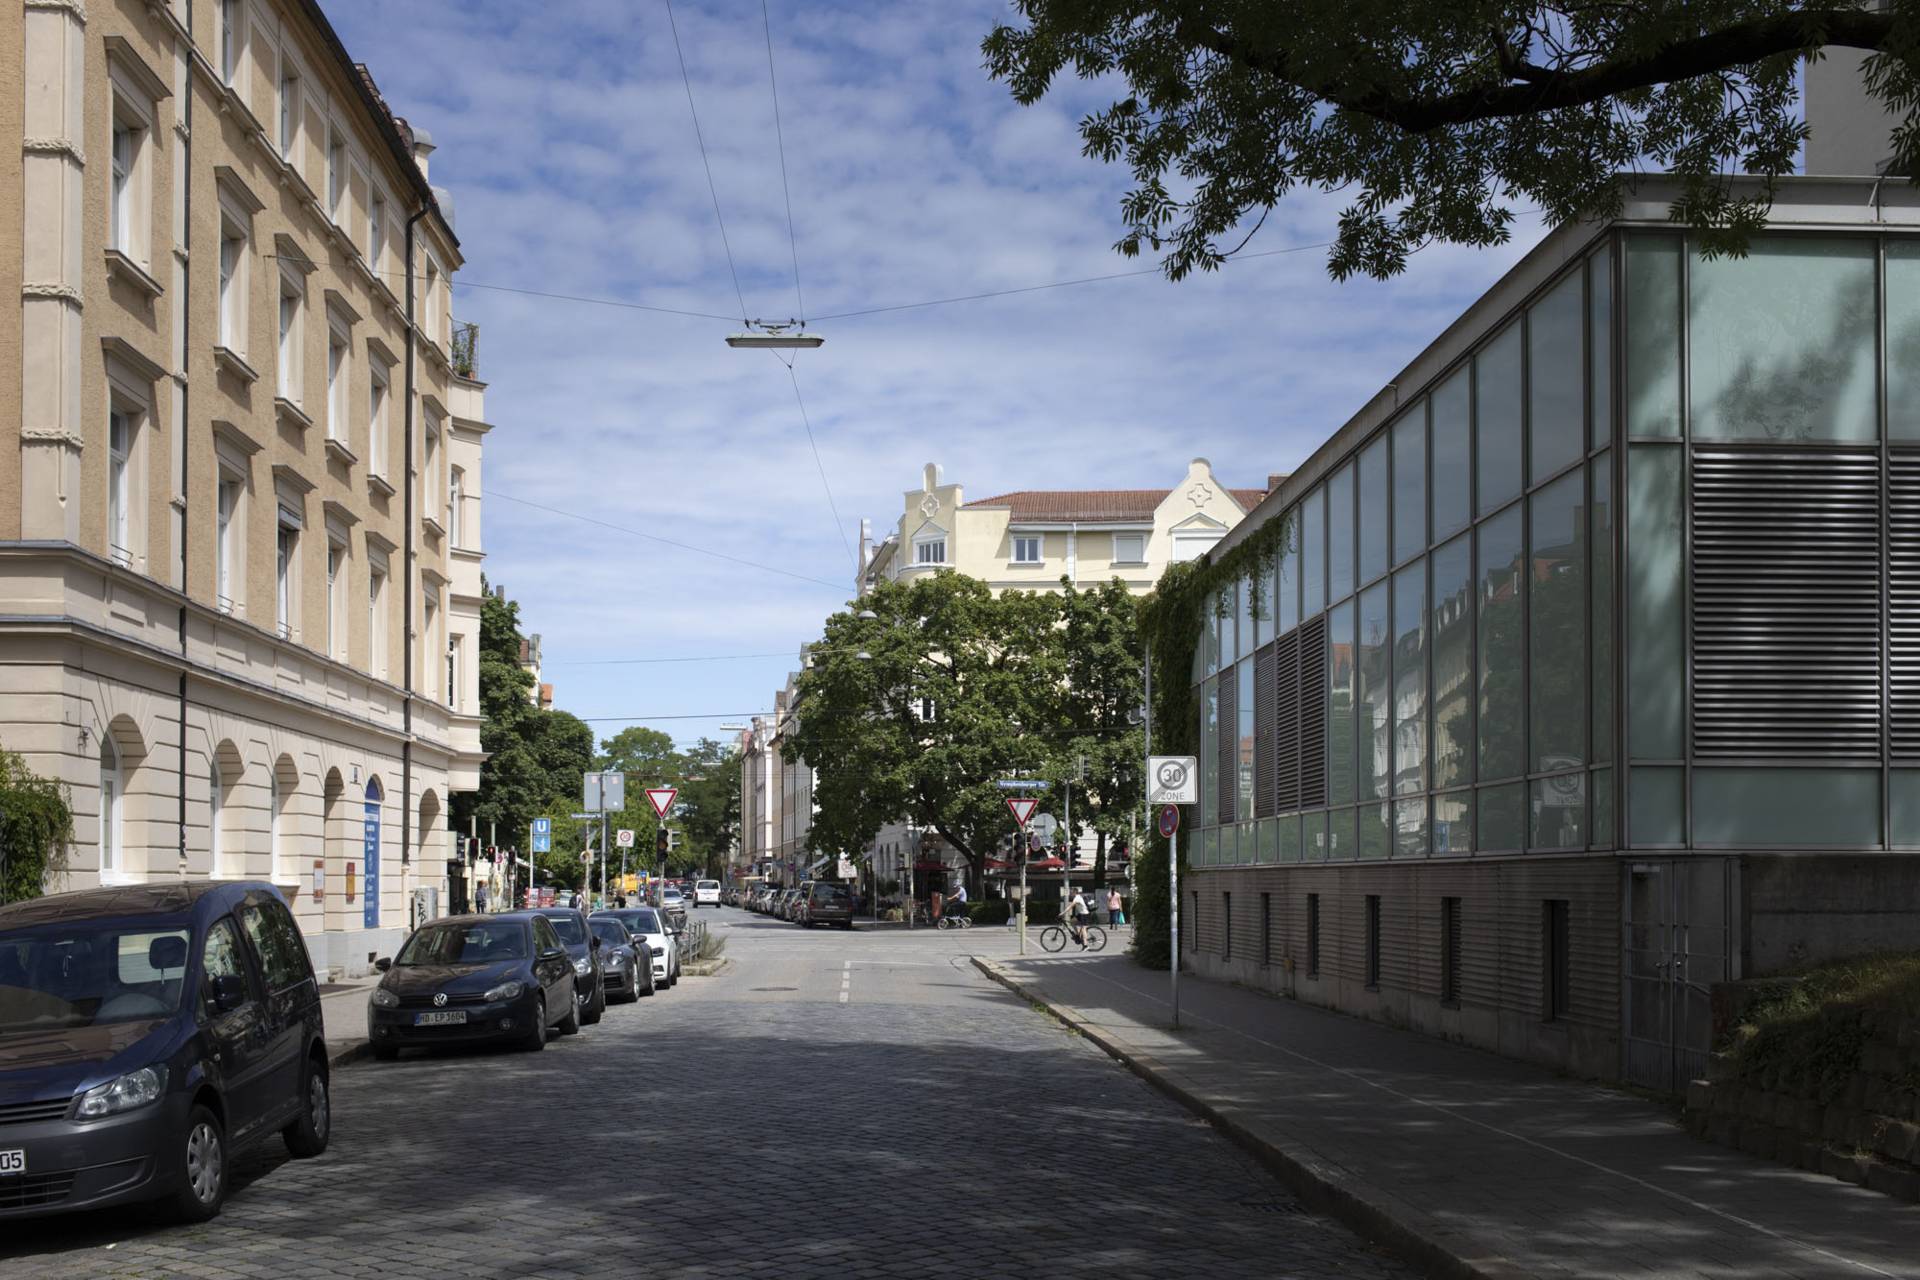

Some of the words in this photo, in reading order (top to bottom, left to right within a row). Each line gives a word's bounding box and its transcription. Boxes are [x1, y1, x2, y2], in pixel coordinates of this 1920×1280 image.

[1163, 768, 1182, 782] 30
[1160, 791, 1185, 801] ZONE
[537, 820, 546, 832] U
